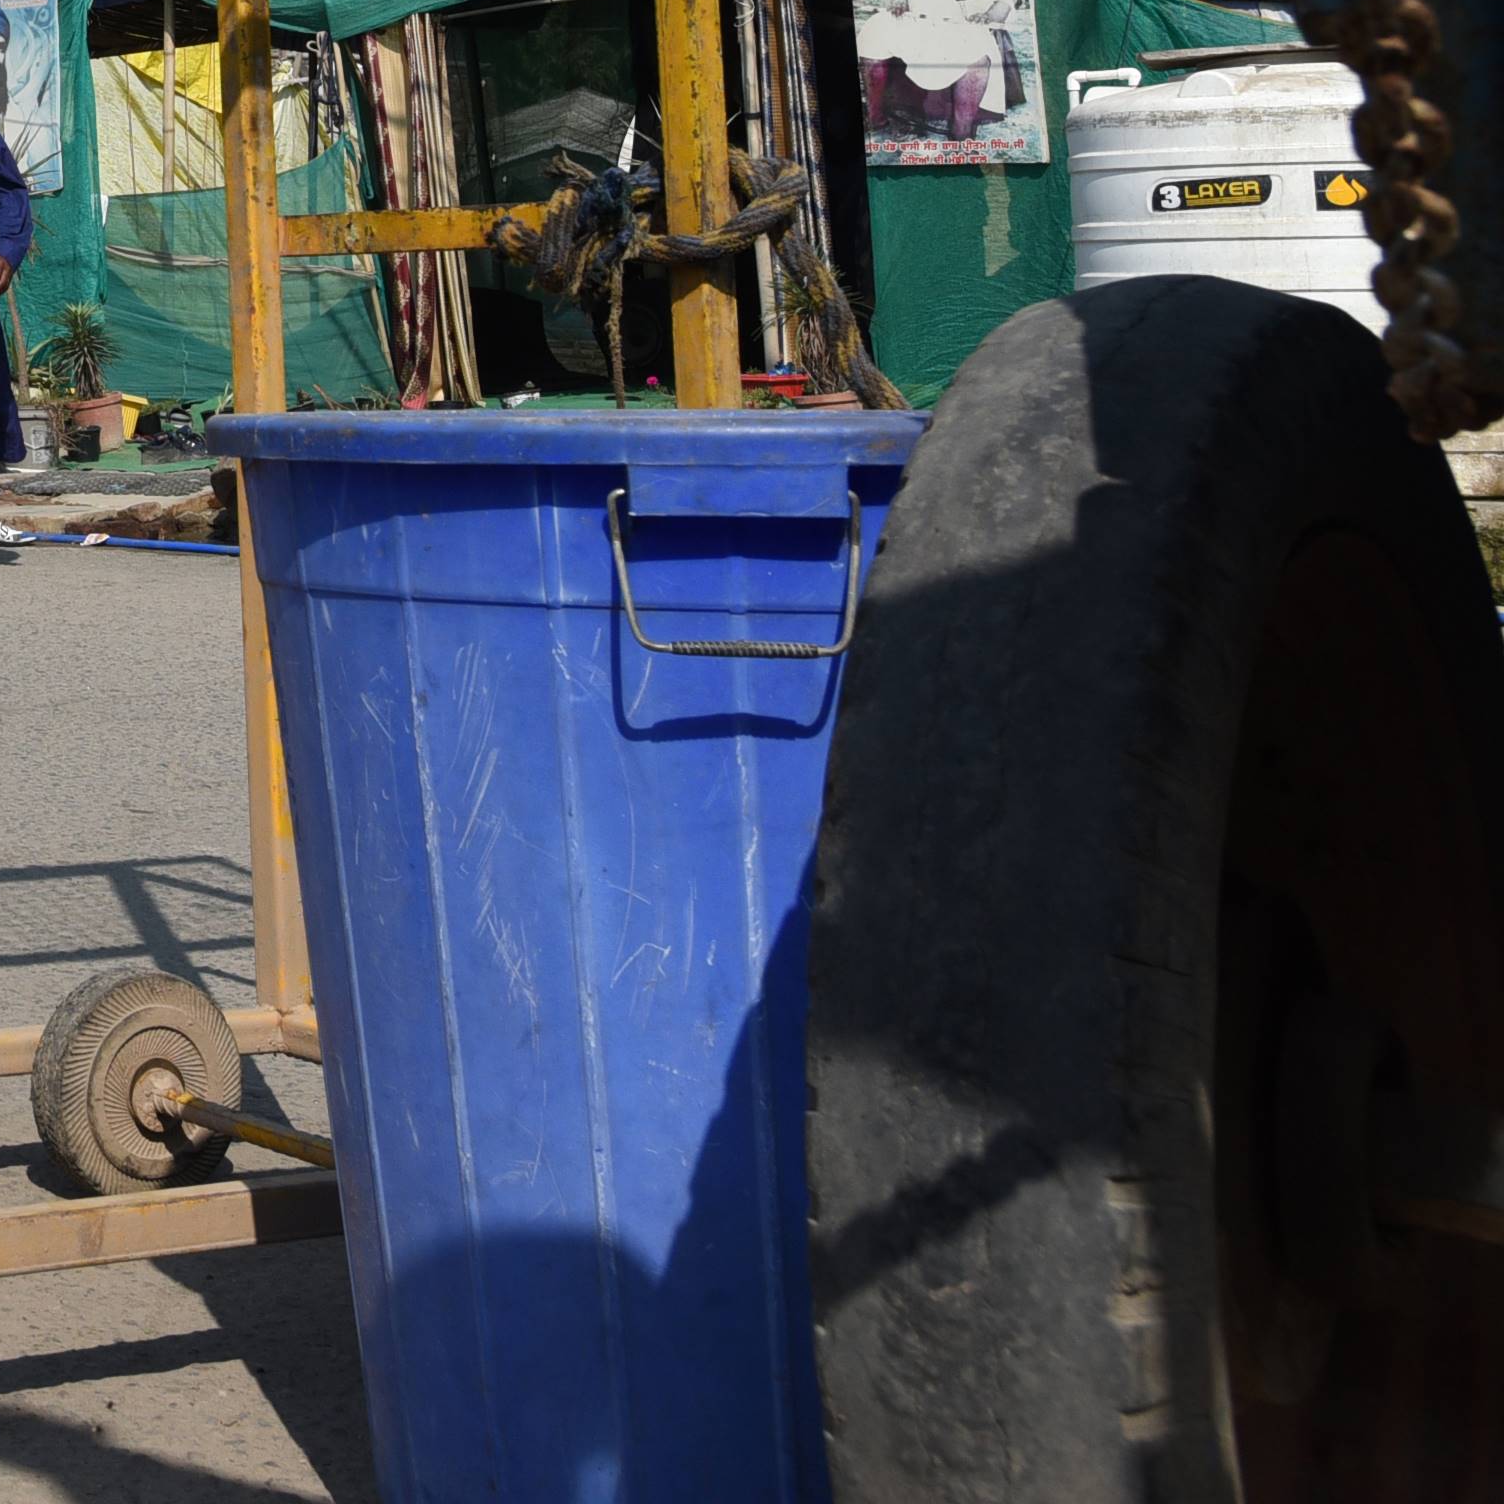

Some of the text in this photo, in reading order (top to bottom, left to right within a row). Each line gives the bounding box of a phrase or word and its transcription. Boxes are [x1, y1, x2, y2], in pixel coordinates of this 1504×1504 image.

[991, 139, 1009, 150] ਸਿੰਘ
[1013, 139, 1024, 149] ਜੀ
[1159, 180, 1260, 209] 3 LAYER
